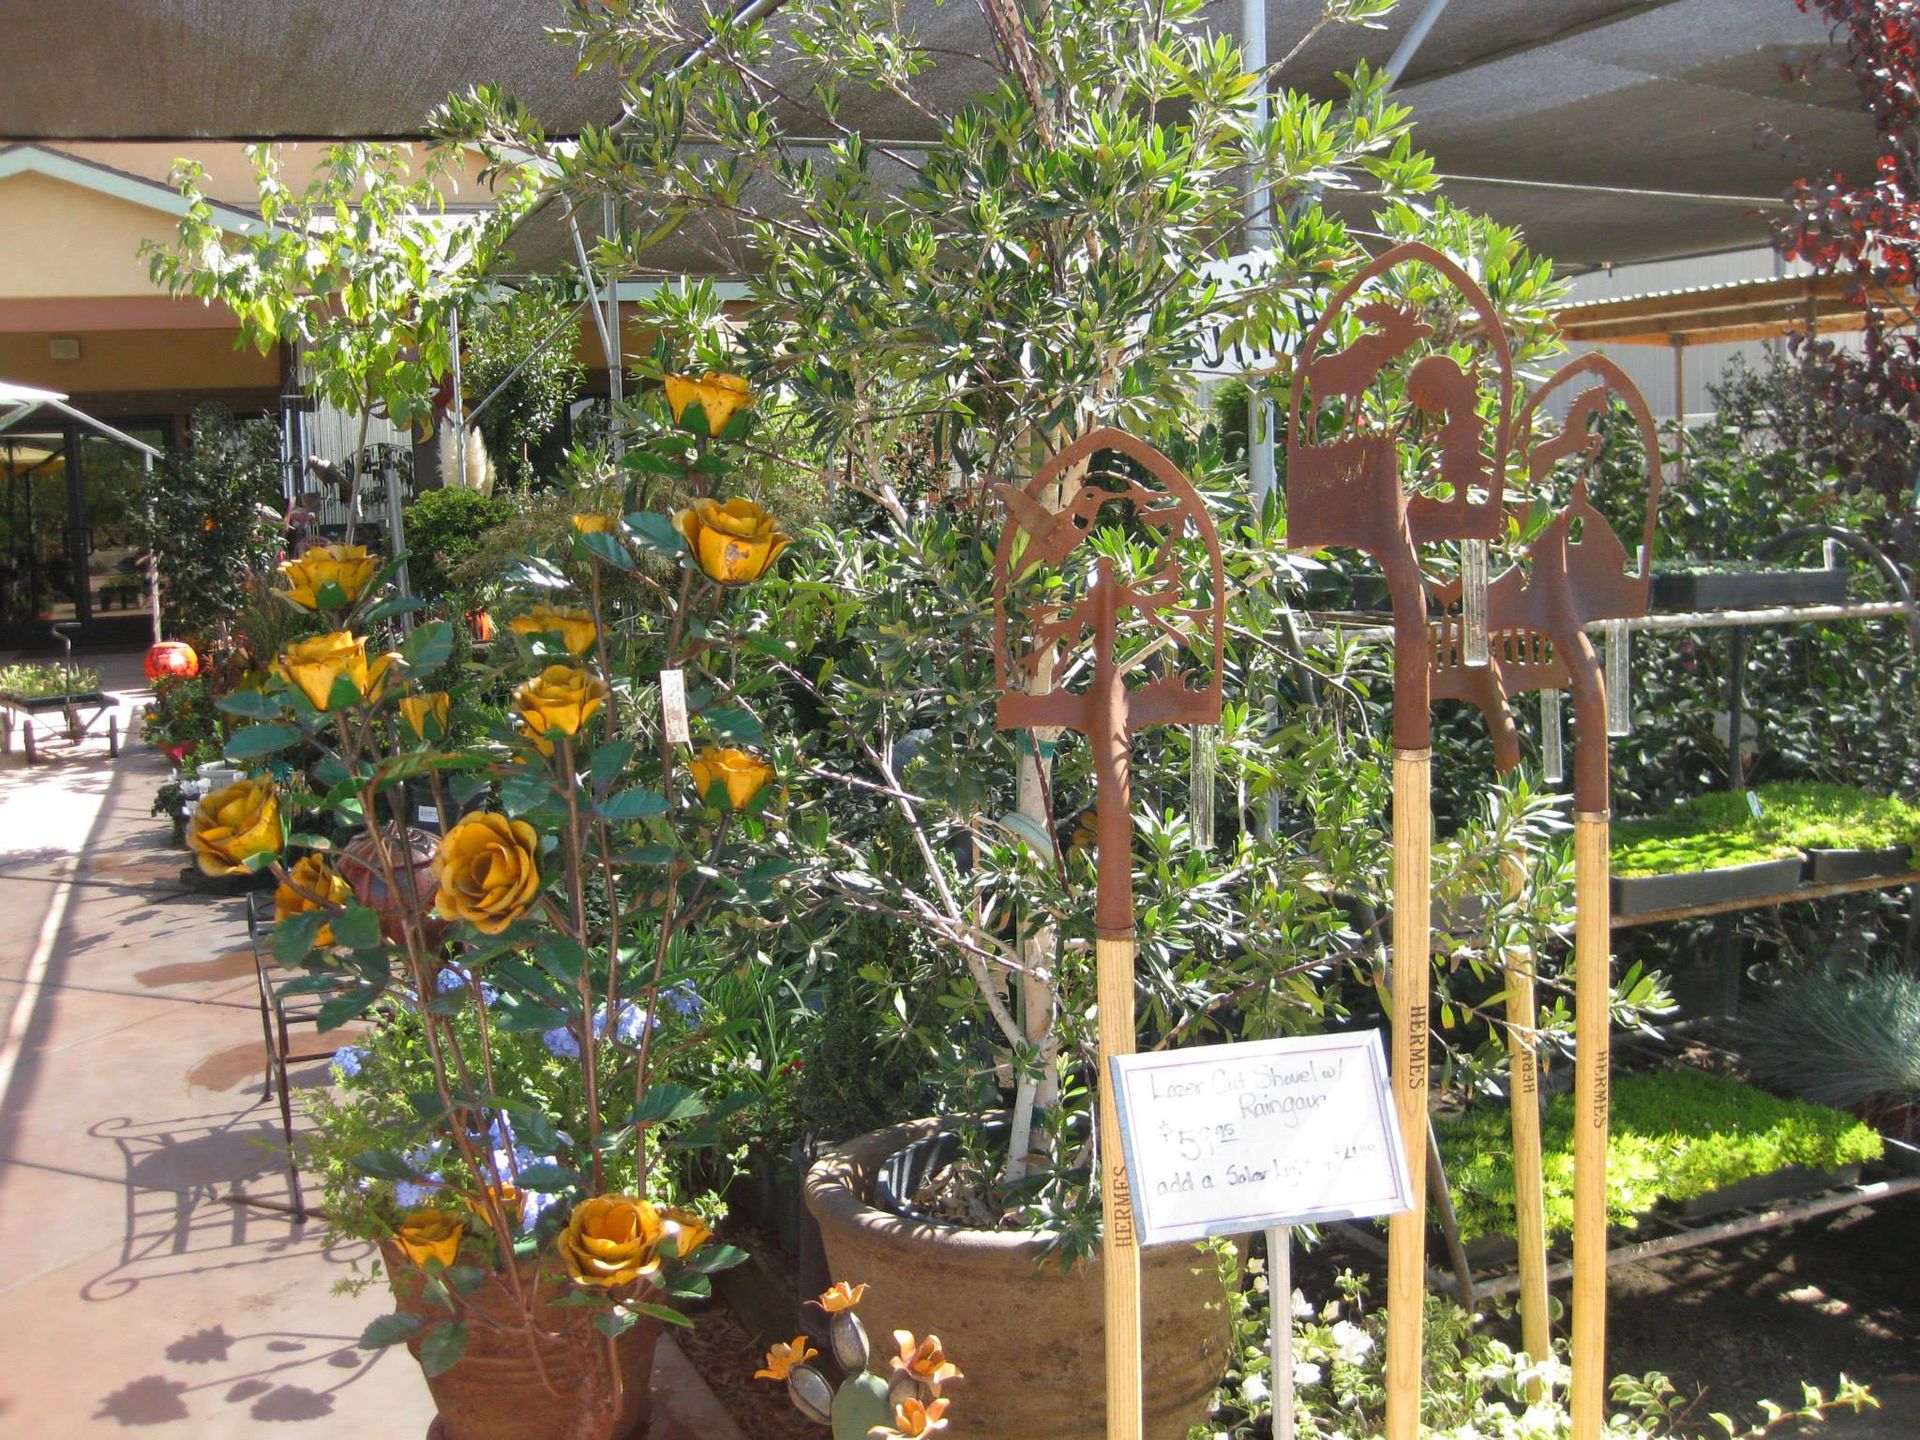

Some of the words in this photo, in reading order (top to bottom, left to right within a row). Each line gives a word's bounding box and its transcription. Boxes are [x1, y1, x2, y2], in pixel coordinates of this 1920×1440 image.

[1211, 1067, 1246, 1095] Cut
[1253, 1059, 1318, 1090] Shovel
[1409, 1006, 1426, 1090] HERMES
[1593, 1050, 1608, 1129] HERMES
[1113, 1166, 1132, 1247] HERMES
[1156, 1170, 1194, 1196] add
[1201, 1173, 1215, 1190] a
